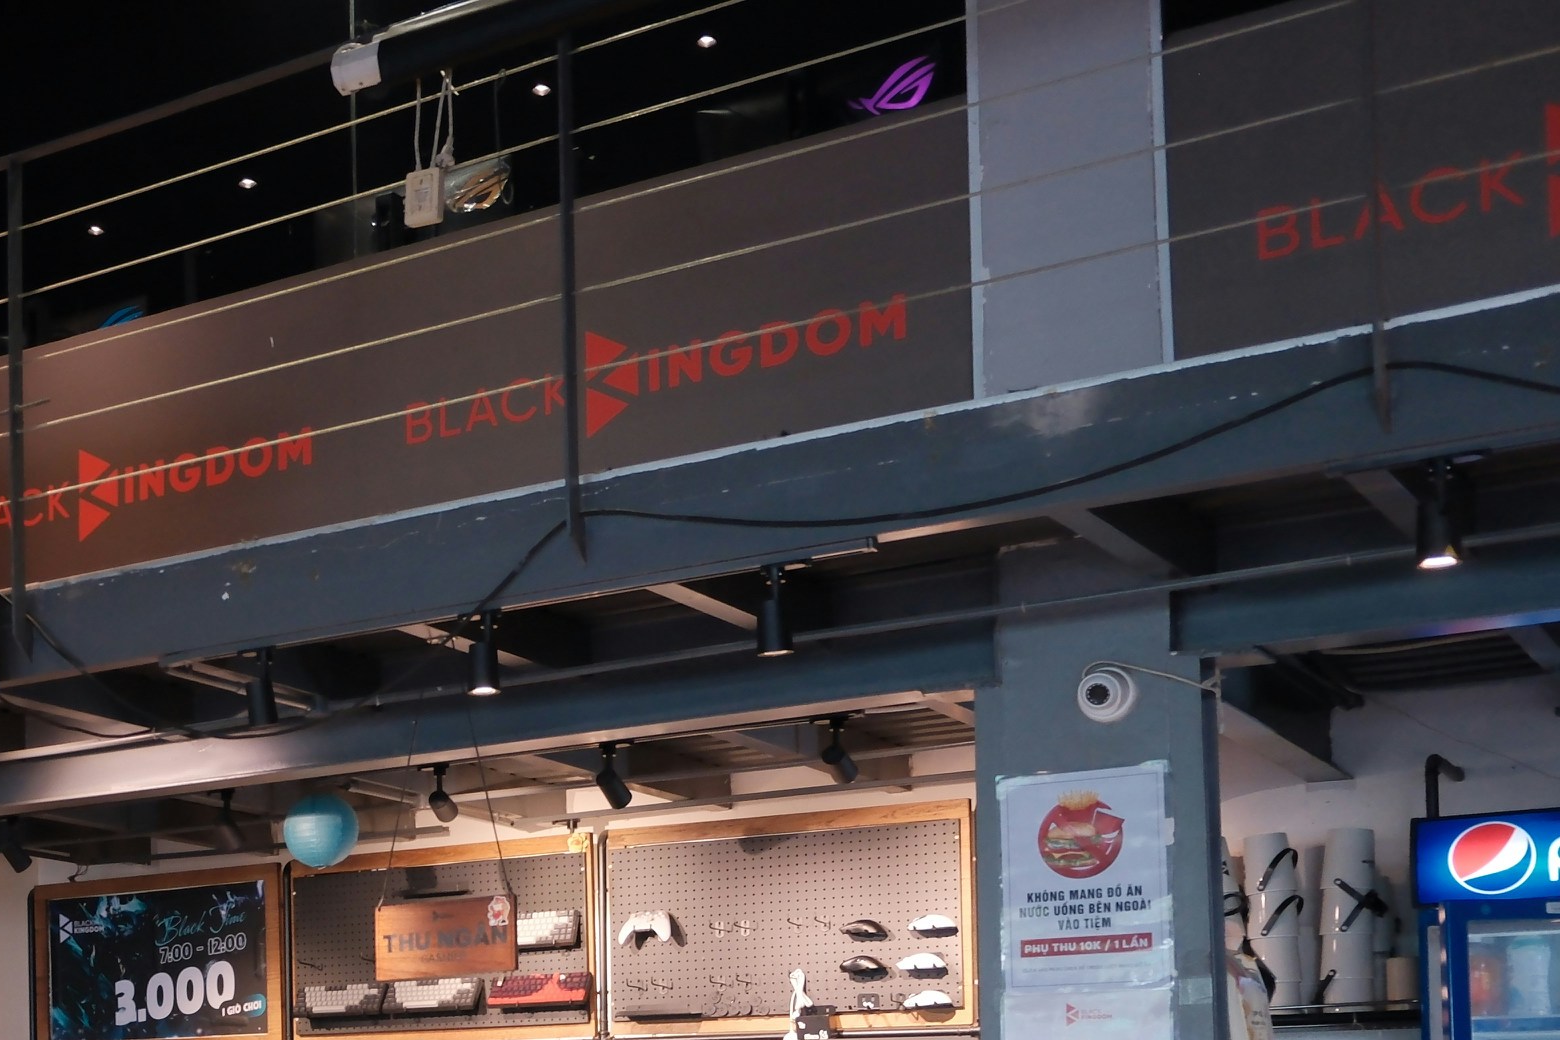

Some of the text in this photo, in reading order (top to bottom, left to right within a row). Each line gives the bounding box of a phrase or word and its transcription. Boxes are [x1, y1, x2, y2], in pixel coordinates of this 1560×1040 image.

[1256, 150, 1525, 261] BLACK
[1069, 888, 1103, 901] MANG
[159, 942, 193, 965] 7:00
[207, 932, 247, 956] 12:00
[383, 919, 508, 954] THU NGÂN
[1052, 941, 1076, 952] THU
[1079, 940, 1101, 951] 10K
[114, 960, 236, 1026] 3.000
